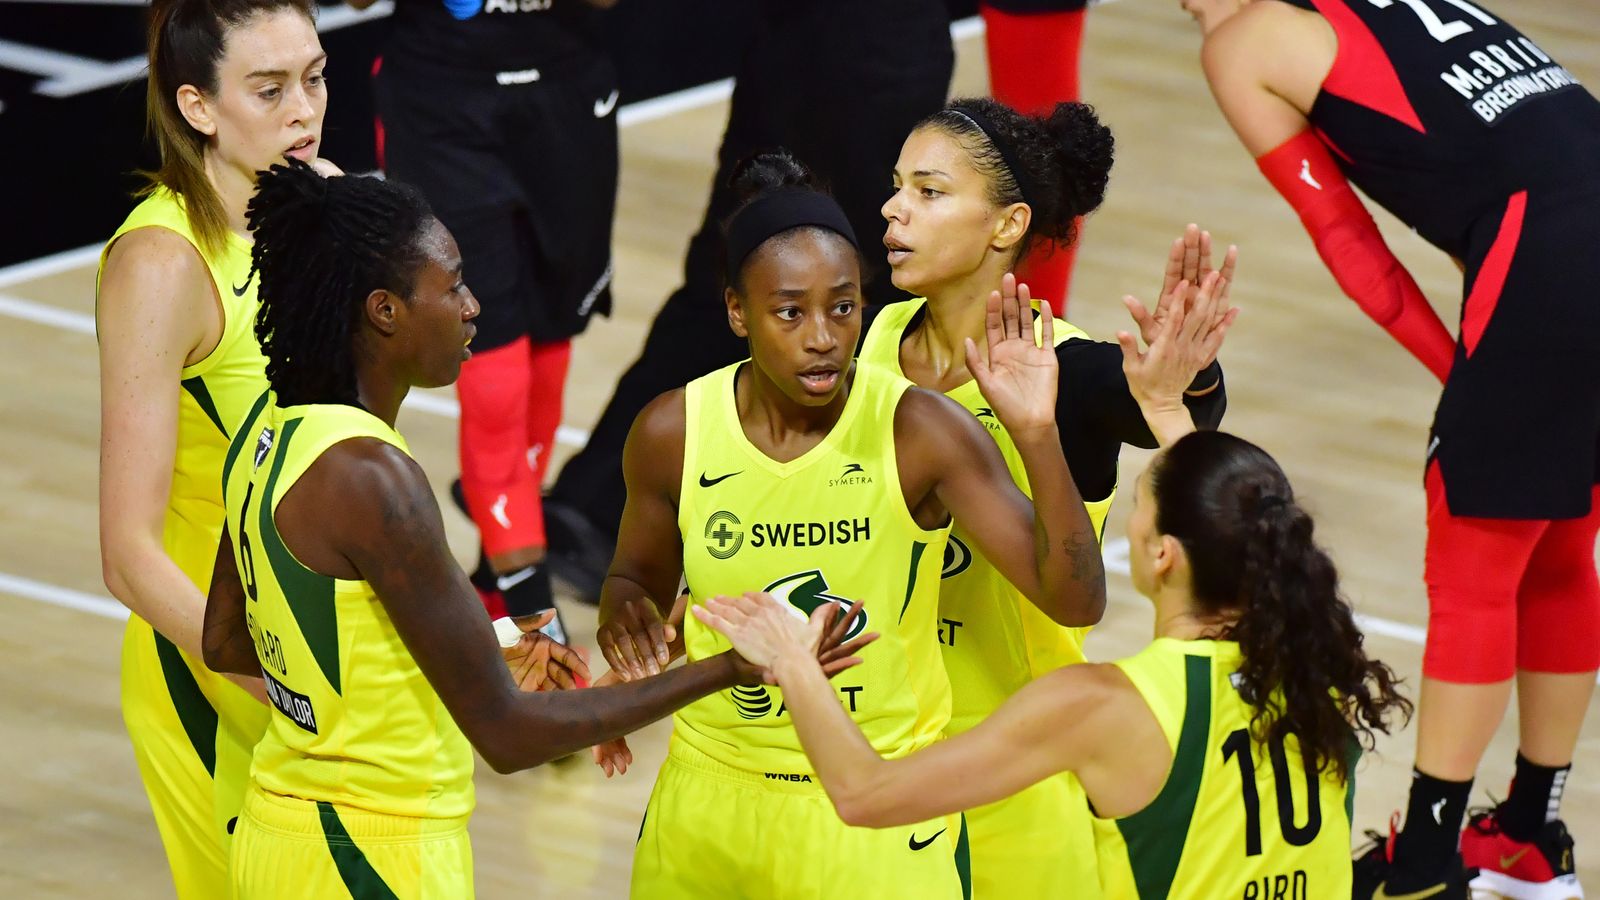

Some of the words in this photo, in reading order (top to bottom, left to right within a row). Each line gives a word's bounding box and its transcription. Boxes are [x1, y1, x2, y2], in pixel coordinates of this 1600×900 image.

[829, 476, 873, 487] SYMETRA
[239, 481, 258, 603] 6
[750, 517, 871, 548] SWEDISH
[764, 772, 812, 784] WNBA
[1221, 722, 1322, 857] 10
